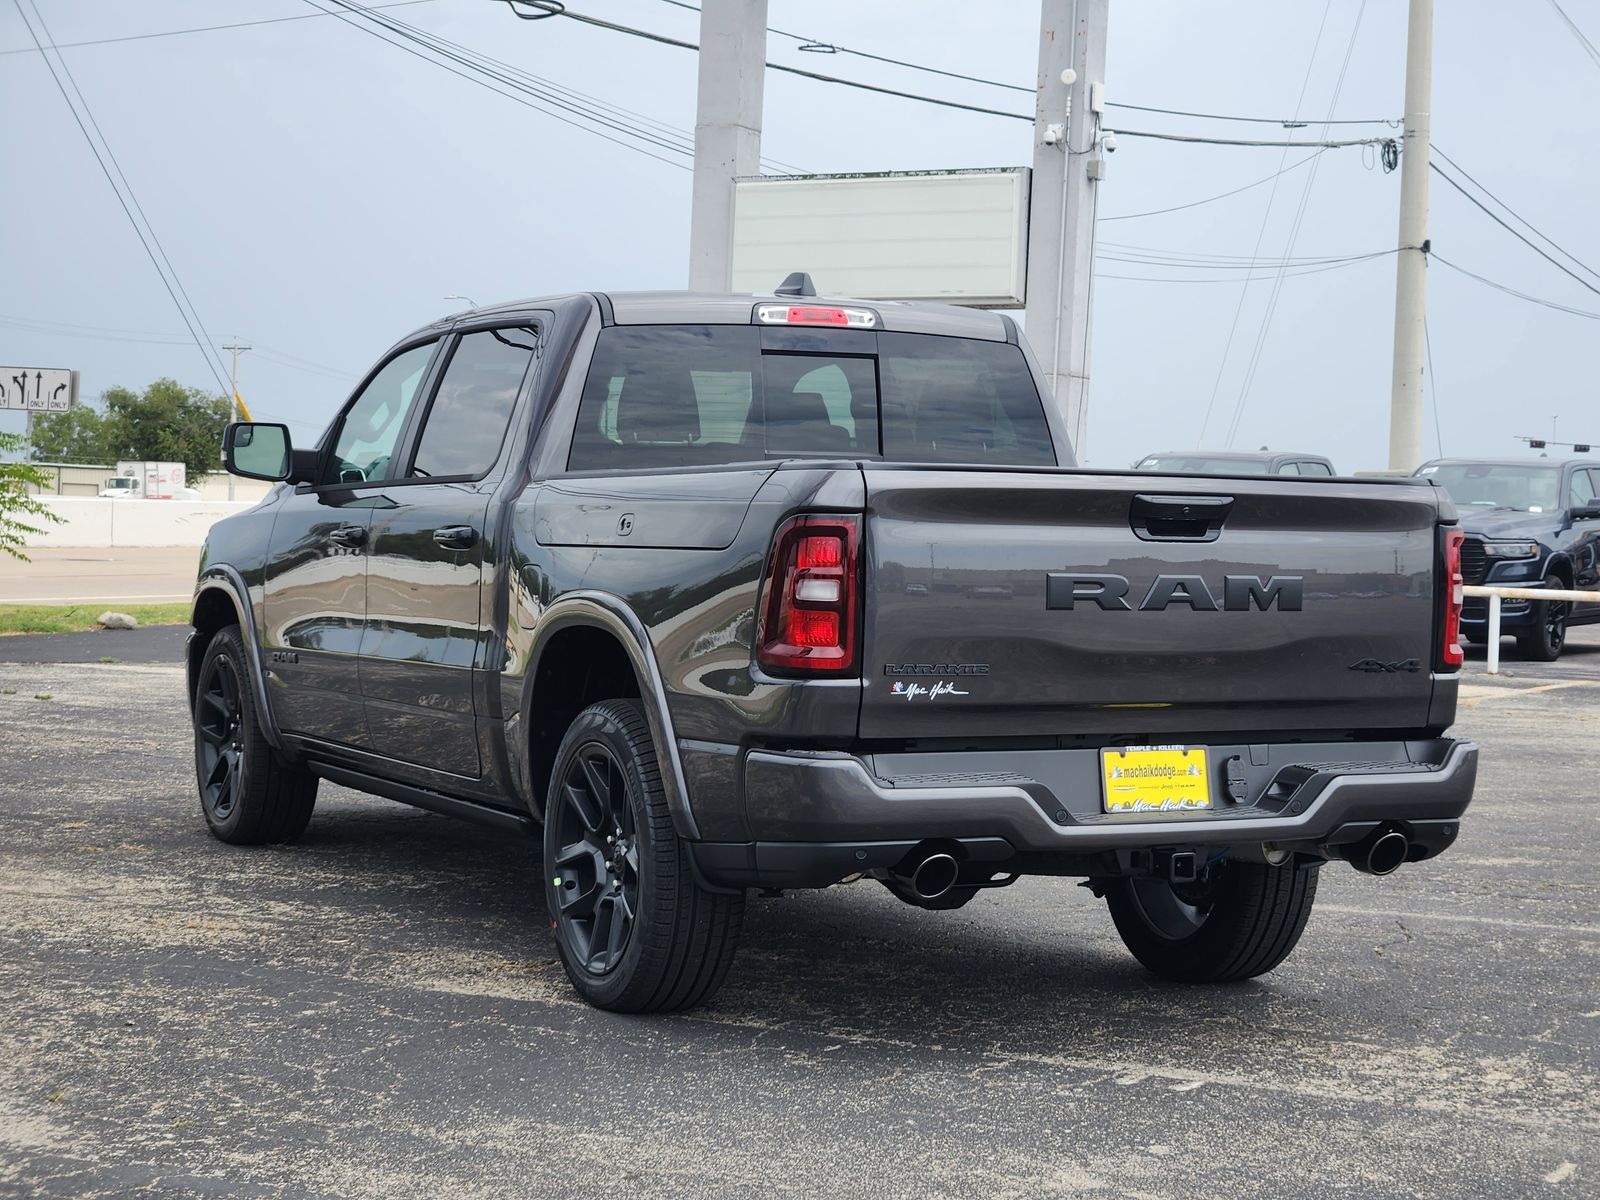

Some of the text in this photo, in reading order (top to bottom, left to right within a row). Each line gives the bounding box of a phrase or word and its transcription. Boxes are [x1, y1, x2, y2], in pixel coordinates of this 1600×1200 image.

[30, 400, 44, 408] ONLY
[50, 401, 67, 409] ONLY
[1047, 573, 1303, 611] RAM
[272, 651, 299, 664] RAM
[884, 663, 990, 676] LARAMIE
[905, 680, 969, 701] Mac Haik
[1123, 764, 1188, 779] machaikdodge.com
[1131, 799, 1160, 813] Mac
